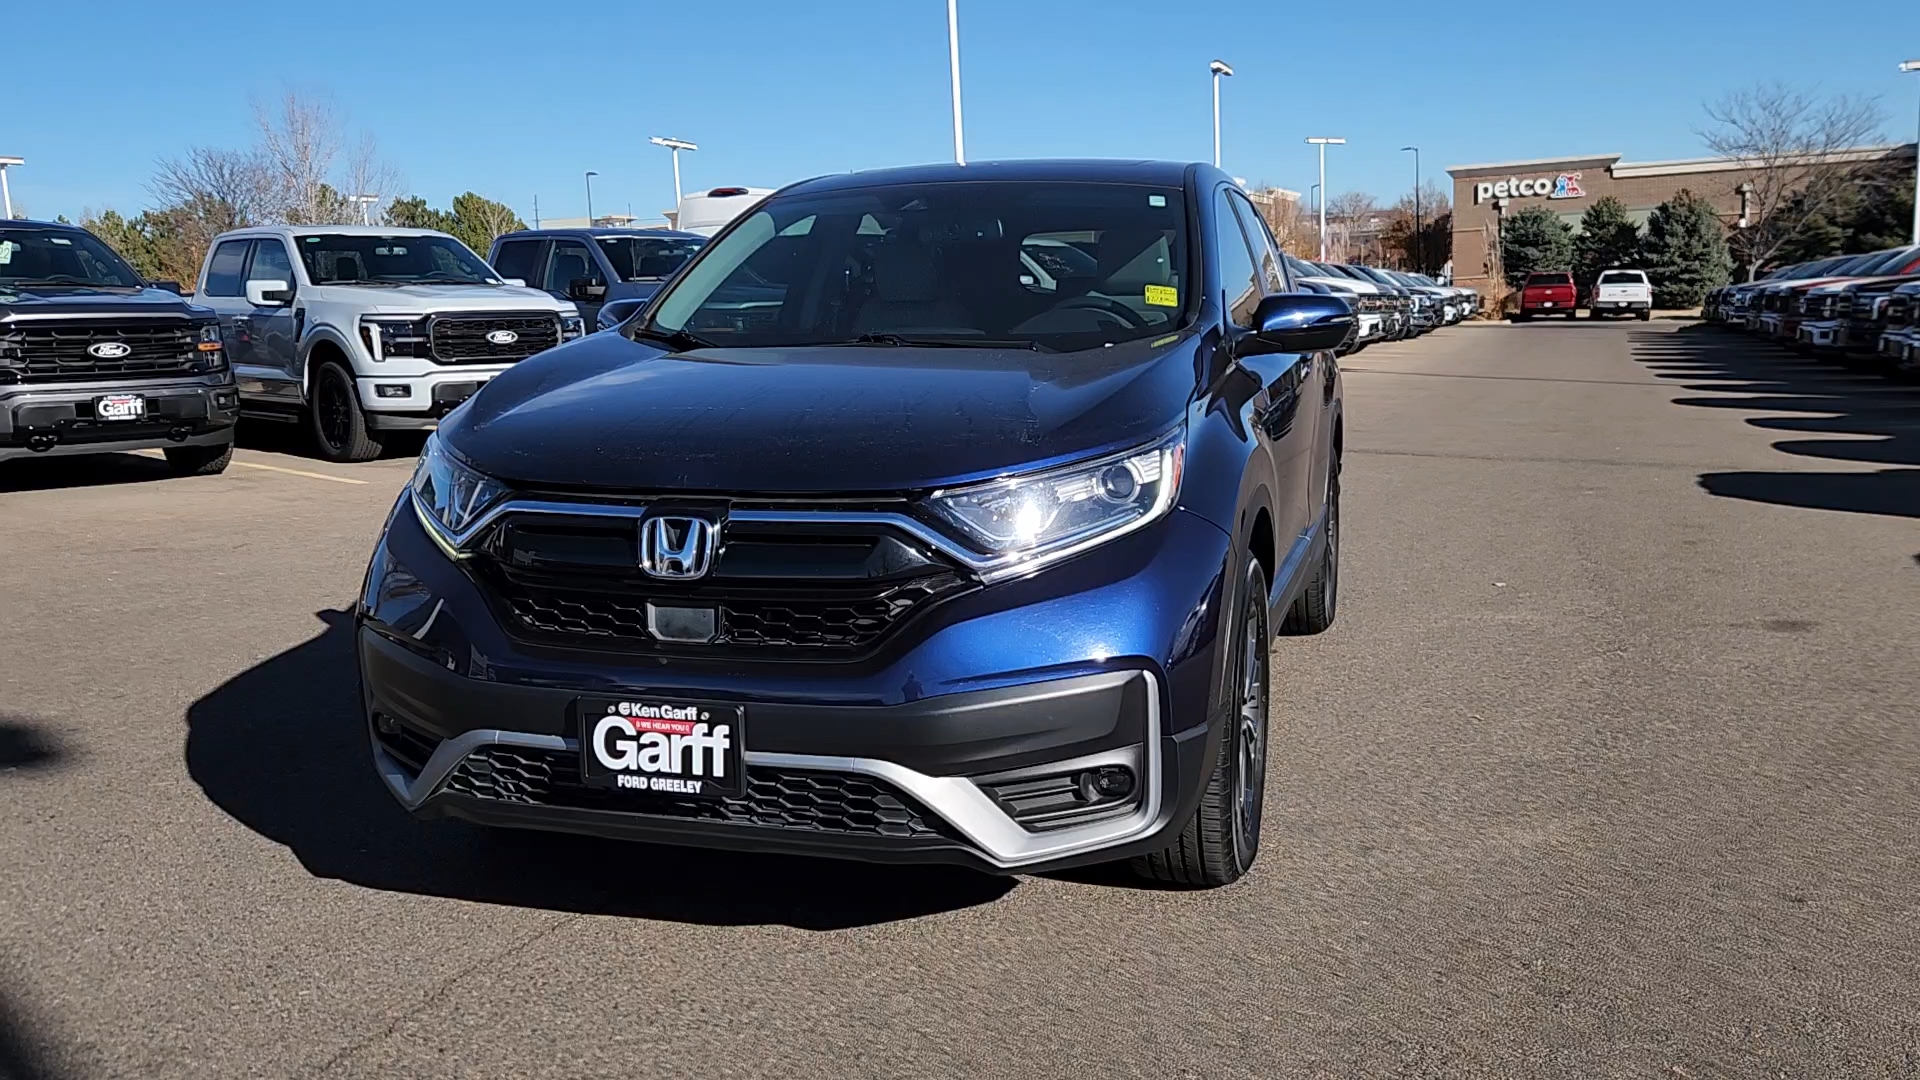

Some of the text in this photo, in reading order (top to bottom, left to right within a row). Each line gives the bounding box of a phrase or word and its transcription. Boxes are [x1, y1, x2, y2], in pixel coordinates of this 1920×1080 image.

[1477, 176, 1551, 203] petco
[98, 398, 143, 417] Garff
[631, 702, 697, 721] Ken Garff
[641, 721, 685, 732] WE HEAR YOU
[593, 715, 730, 777] Garff
[617, 774, 702, 794] FORD GREELEY
